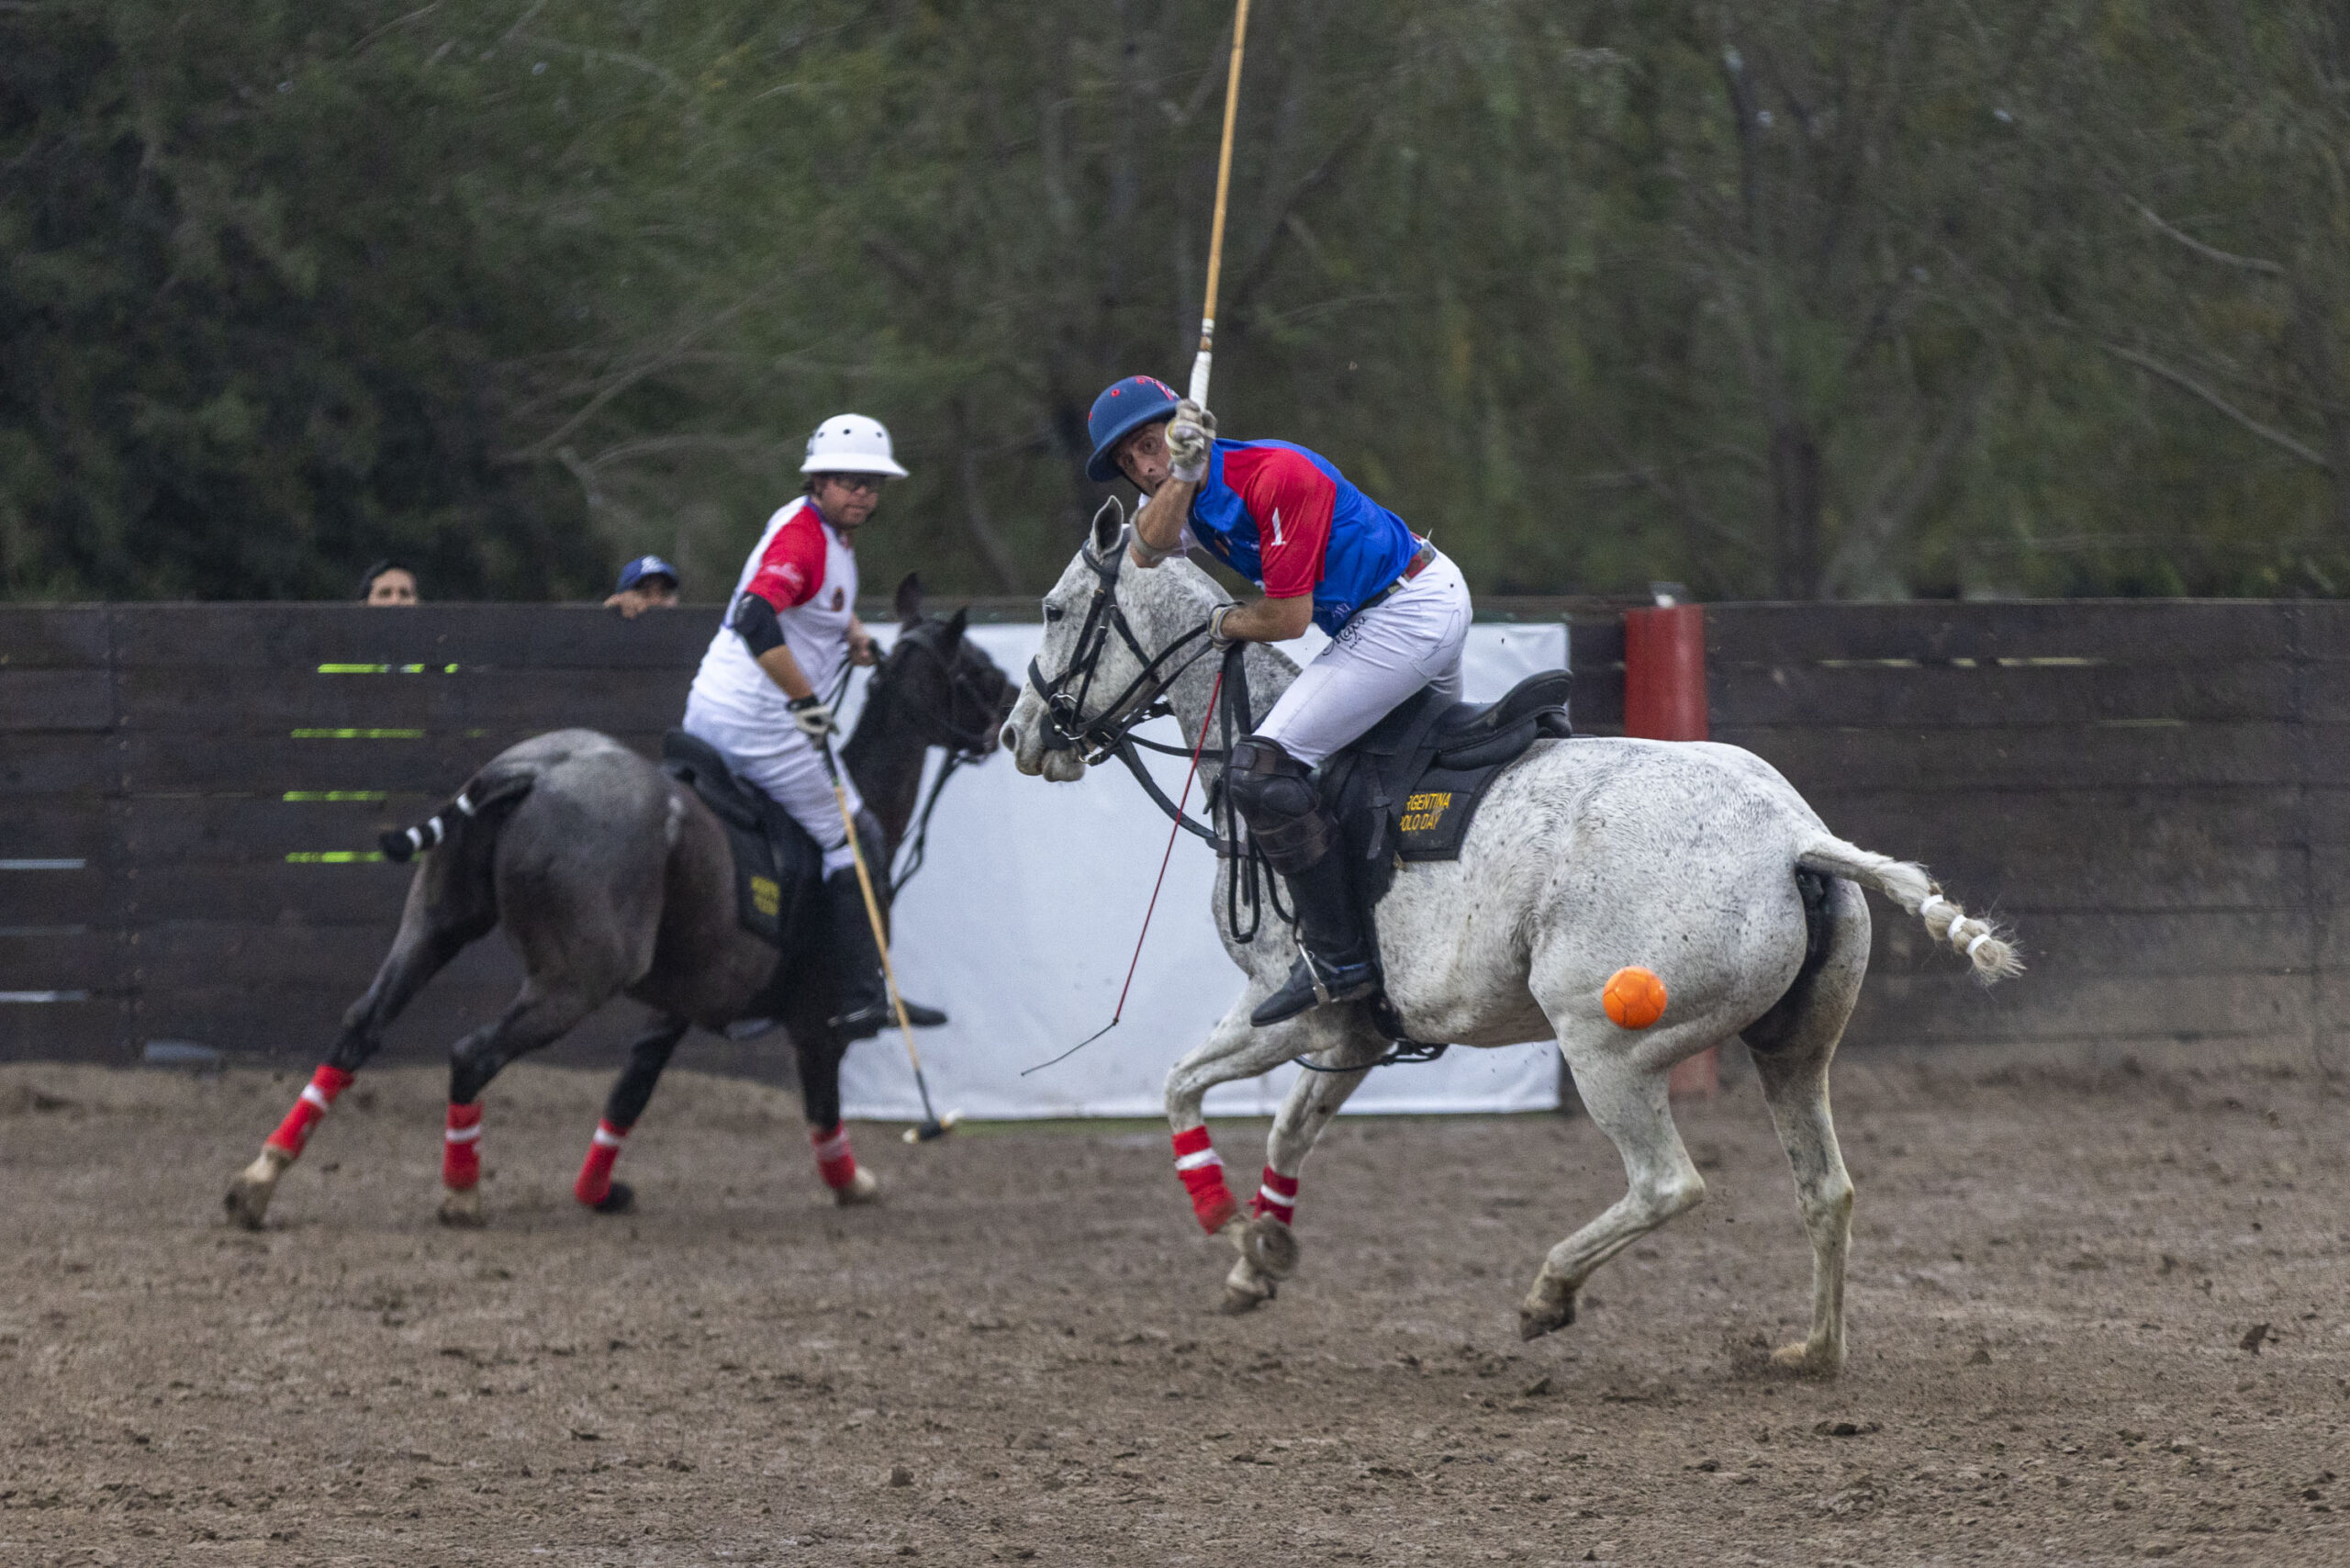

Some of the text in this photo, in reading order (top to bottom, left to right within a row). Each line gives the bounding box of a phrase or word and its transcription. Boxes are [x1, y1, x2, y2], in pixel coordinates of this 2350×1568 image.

[1406, 792, 1452, 812] RGENTINA
[1399, 812, 1442, 832] OLO DAY
